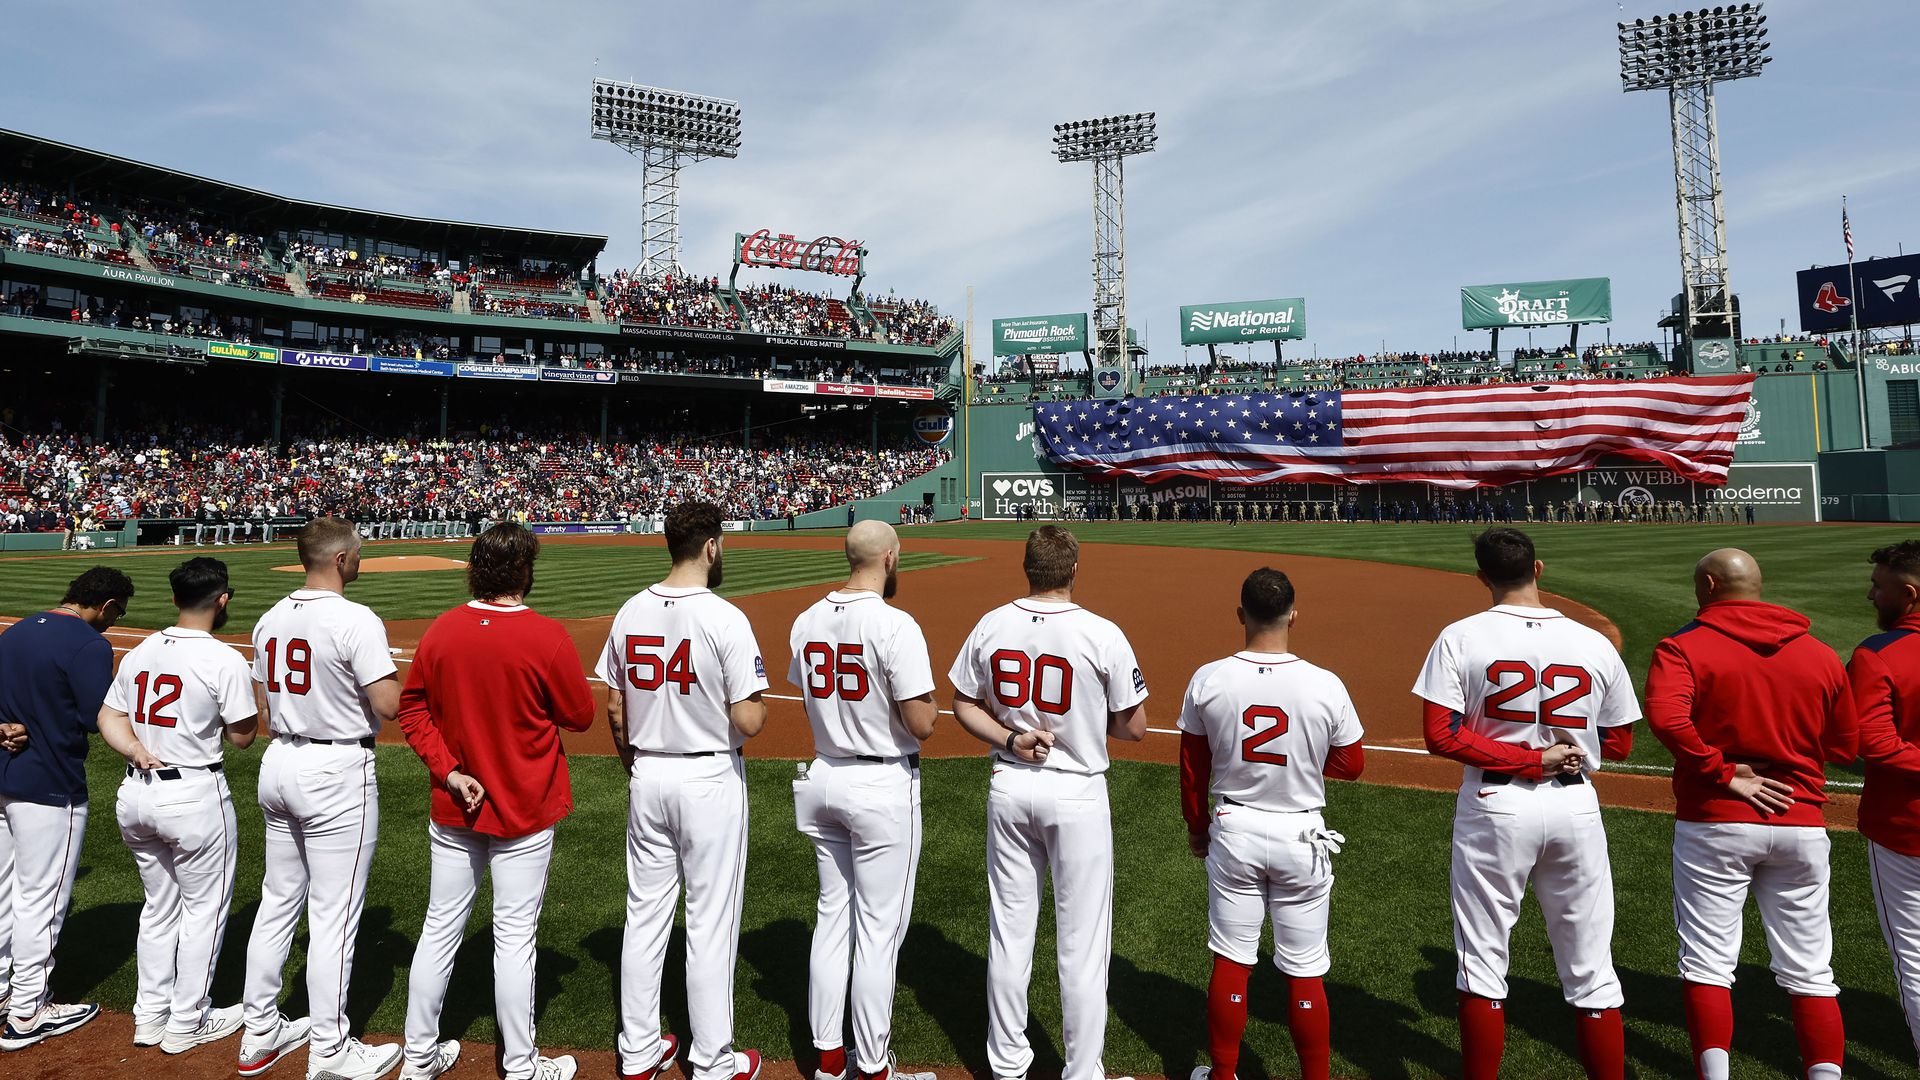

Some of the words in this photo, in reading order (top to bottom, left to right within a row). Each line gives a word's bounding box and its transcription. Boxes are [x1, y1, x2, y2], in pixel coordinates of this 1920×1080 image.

[741, 229, 865, 275] Coca-Cola
[134, 273, 175, 287] PAVILION
[1499, 297, 1570, 314] DRAFT
[1507, 310, 1569, 323] KINGS
[1003, 326, 1048, 340] Plymouth
[1050, 324, 1075, 337] Rock
[1241, 327, 1257, 335] Car
[1259, 325, 1290, 334] Rental
[800, 339, 818, 347] LIVES
[819, 341, 844, 349] MATTER
[210, 345, 248, 357] SULLIVAN
[259, 352, 275, 360] TIRE
[313, 356, 351, 366] HYCU
[459, 365, 492, 373] COGHLIN
[493, 367, 537, 375] COMPANIES
[544, 371, 575, 382] vineyard
[878, 388, 906, 396] Safelite
[914, 417, 952, 431] Gulf
[1586, 471, 1618, 486] F.W.
[1624, 471, 1685, 485] WEBB
[1012, 478, 1054, 497] CVS
[1152, 485, 1208, 503] MASON
[1706, 484, 1801, 500] moderna
[970, 500, 981, 508] 310
[1821, 496, 1840, 505] 379
[264, 637, 312, 696] 19
[626, 634, 697, 695] 54
[803, 641, 870, 701] 35
[990, 648, 1073, 715] 80
[134, 671, 183, 728] 12
[1485, 660, 1592, 729] 22
[1242, 704, 1289, 767] 2
